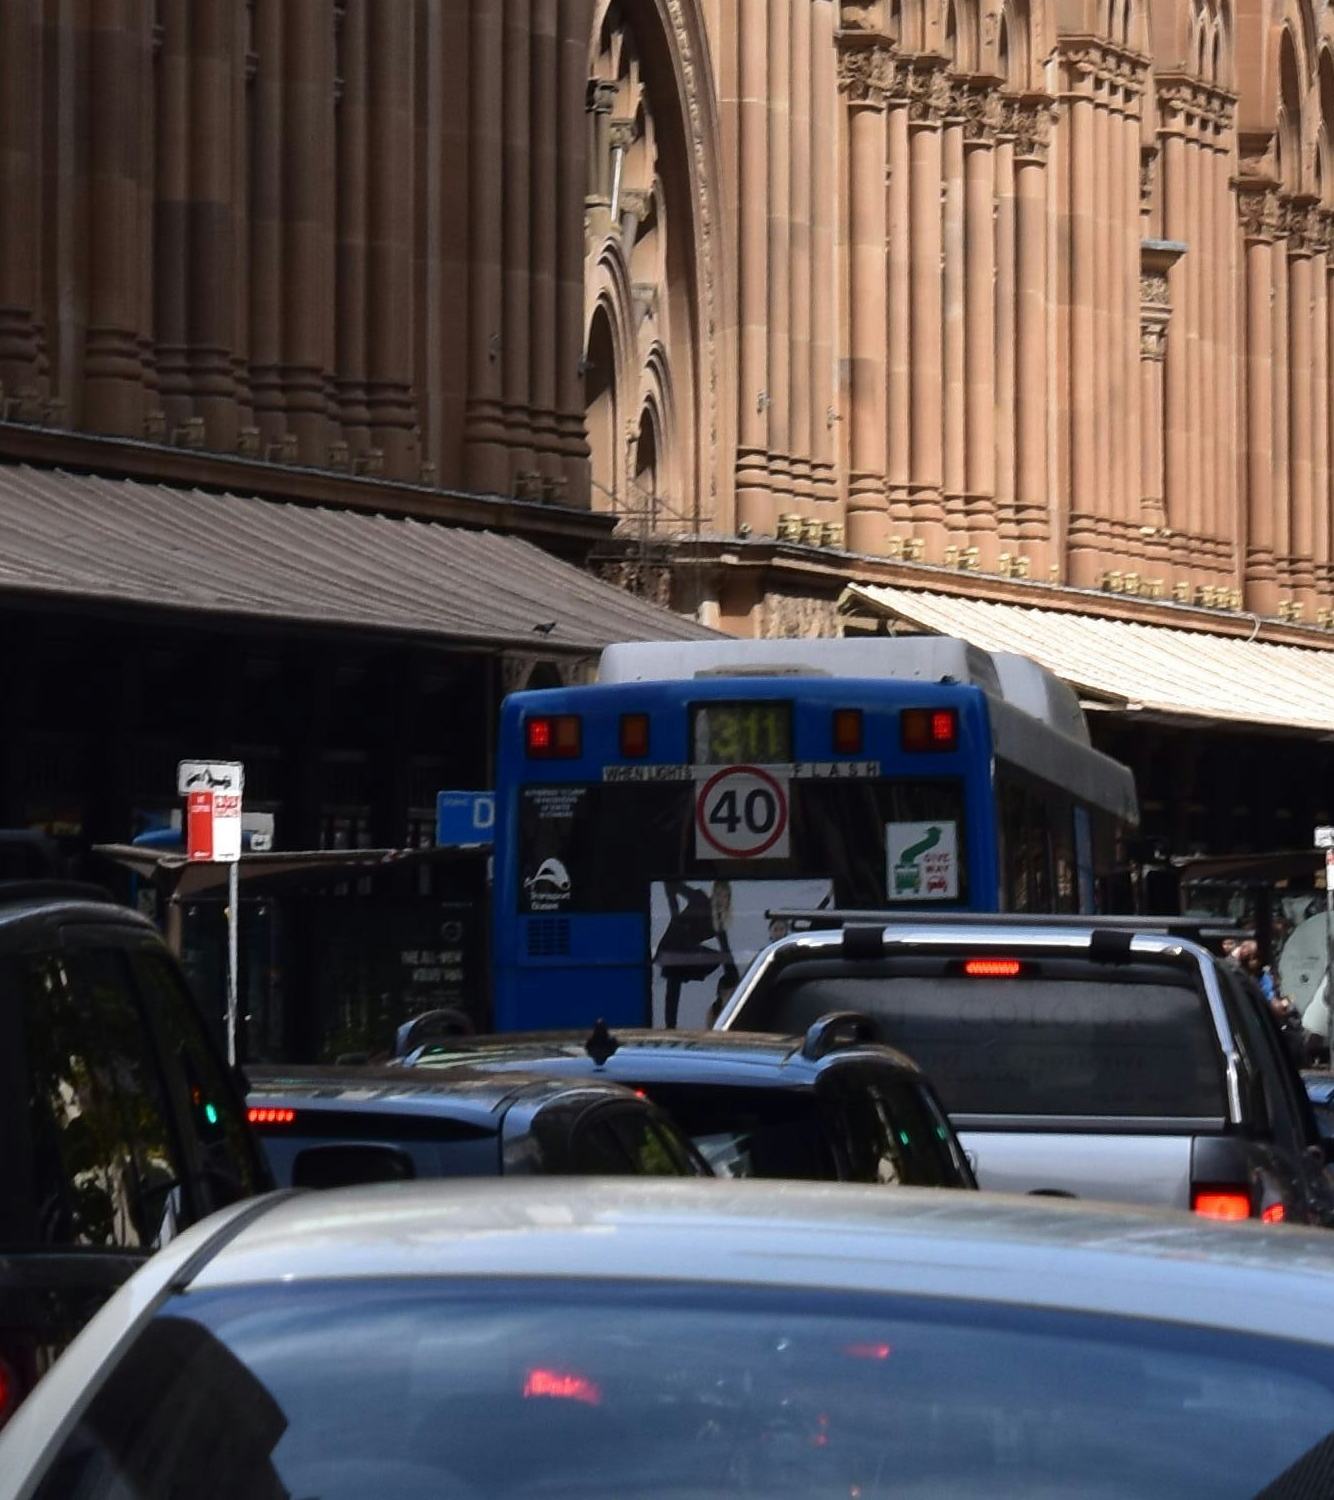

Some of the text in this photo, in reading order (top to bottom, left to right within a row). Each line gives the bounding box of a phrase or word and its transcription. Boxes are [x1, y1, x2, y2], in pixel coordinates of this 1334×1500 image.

[712, 714, 778, 757] 311
[473, 798, 495, 828] D
[709, 788, 776, 834] 40
[924, 853, 950, 863] GIVE
[925, 865, 949, 873] WAY
